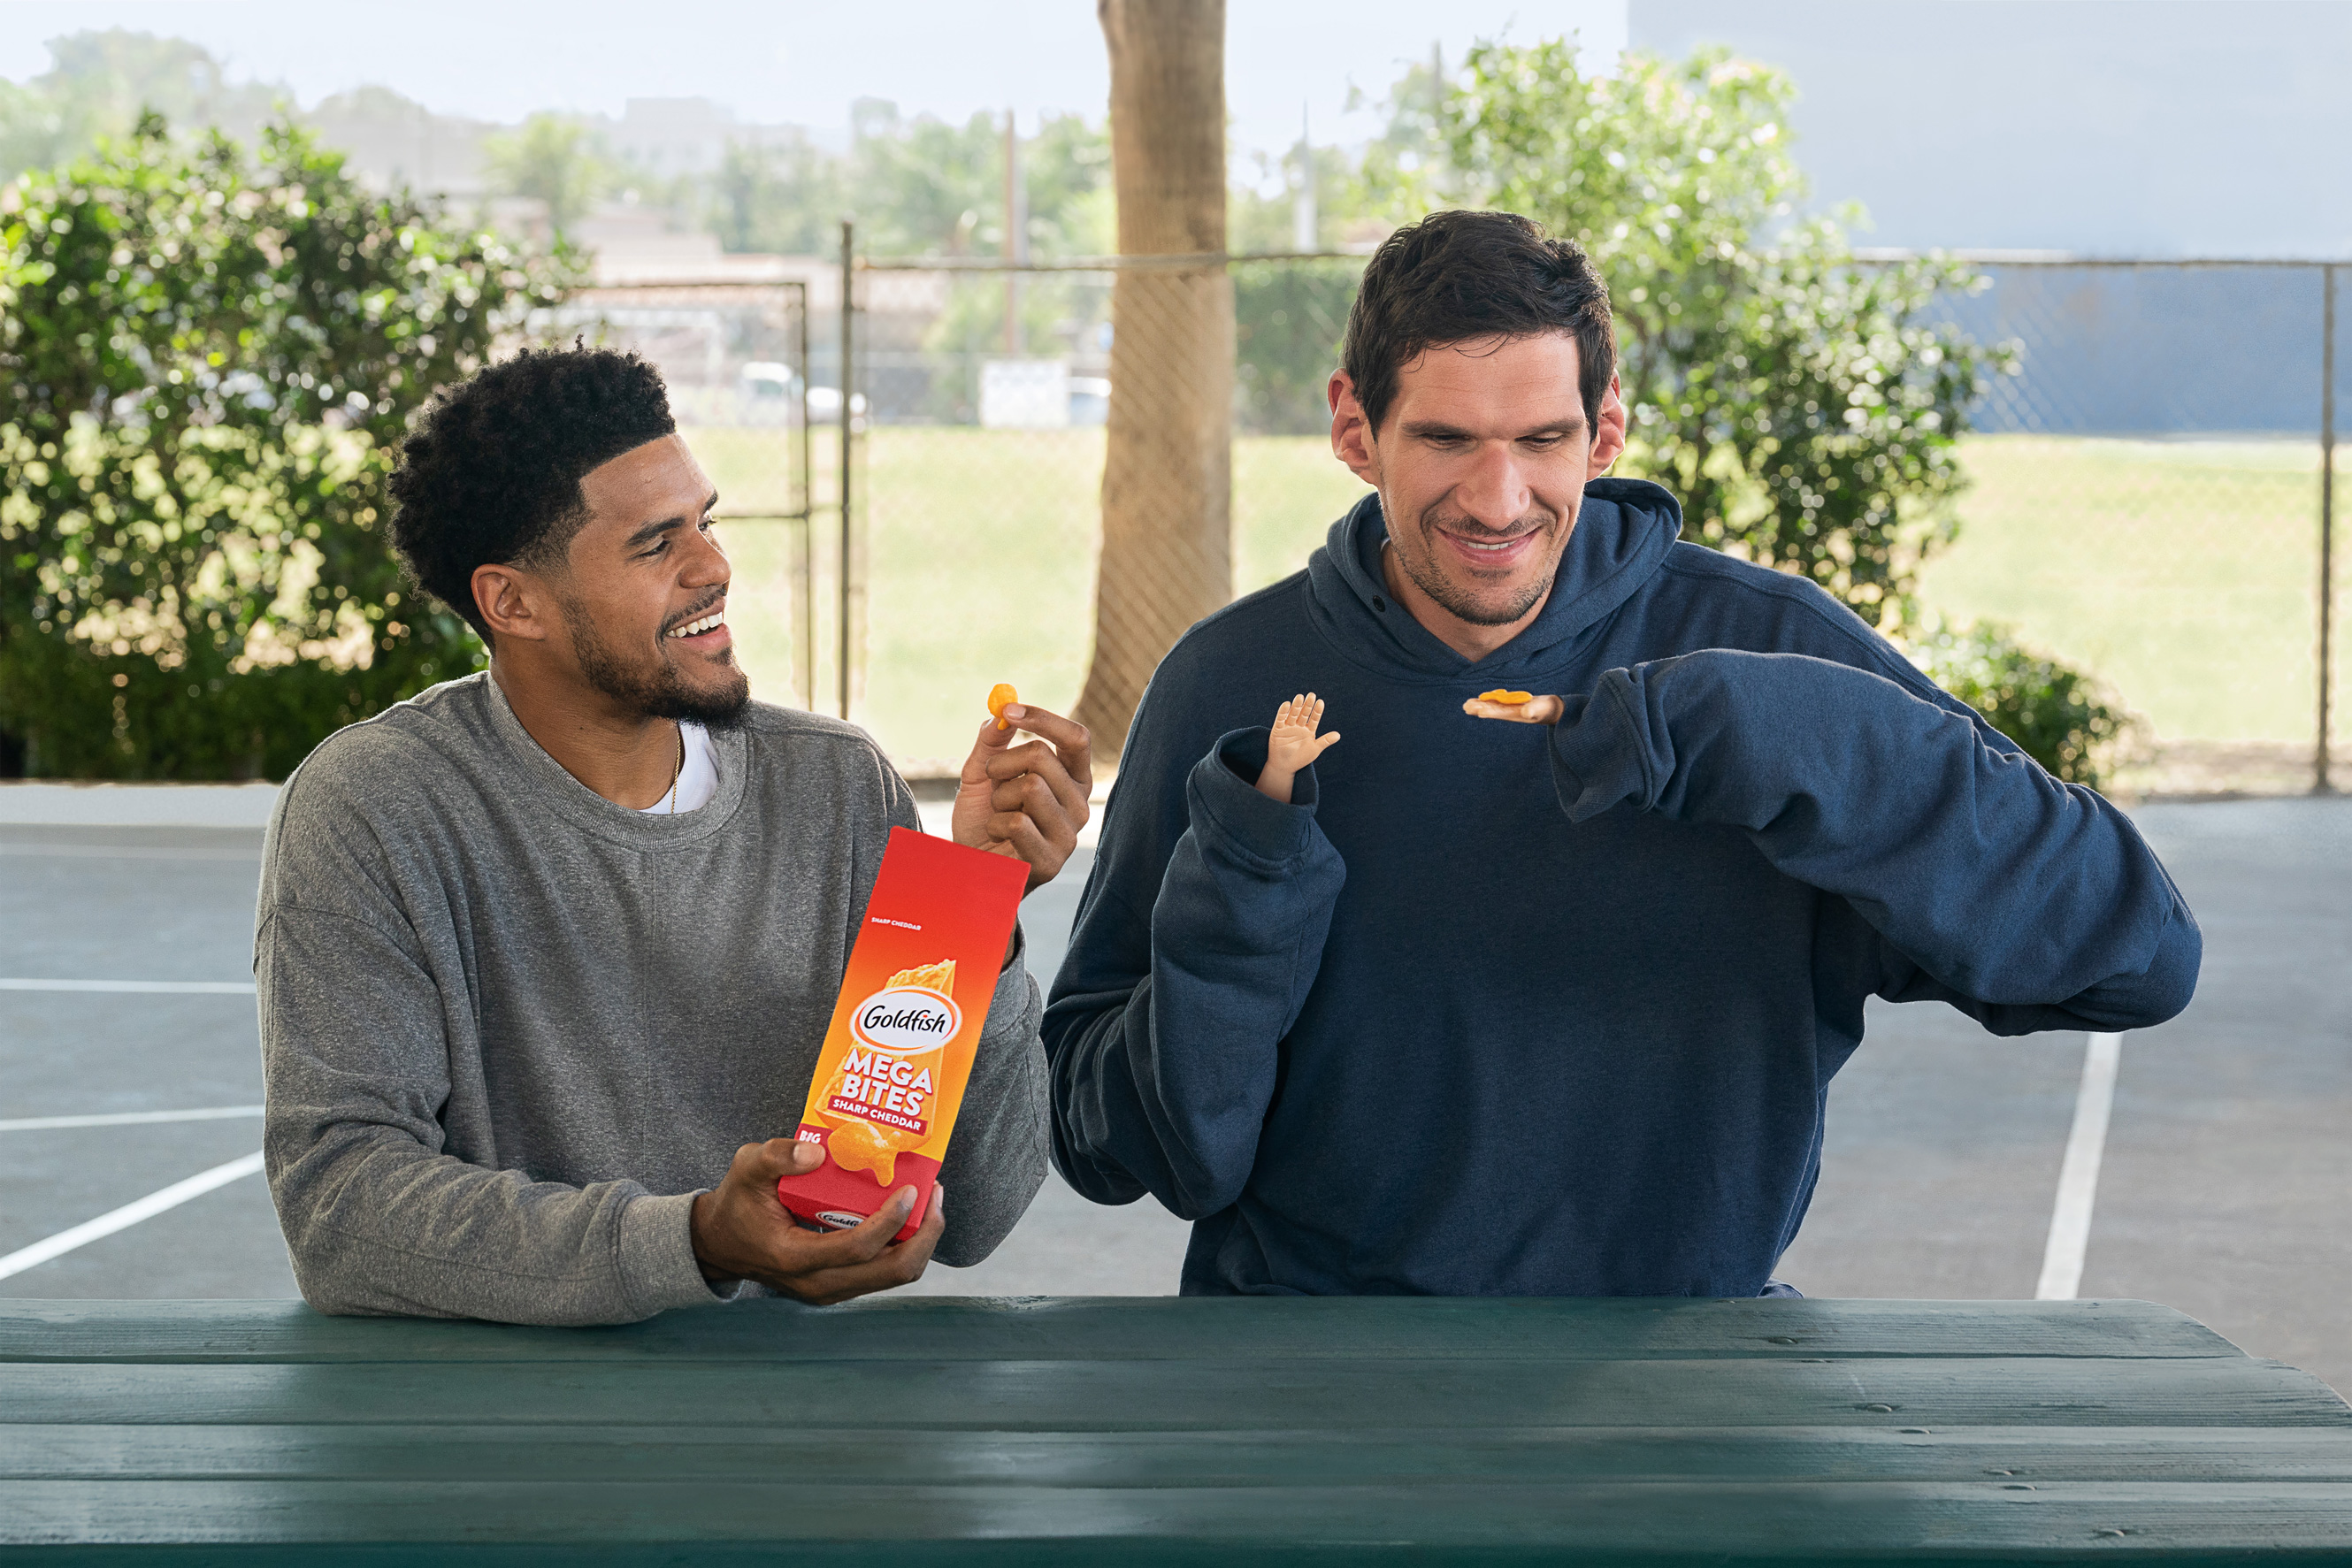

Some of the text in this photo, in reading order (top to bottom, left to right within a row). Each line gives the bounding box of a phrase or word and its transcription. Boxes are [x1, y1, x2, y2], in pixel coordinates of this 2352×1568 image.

[891, 920, 922, 930] CHEDDAR
[863, 1005, 946, 1034] Goldfish
[843, 1047, 933, 1095] MEGA
[840, 1073, 923, 1116] BITES
[832, 1098, 922, 1131] SHARP CHEDDAR
[799, 1129, 821, 1144] BIG
[823, 1214, 859, 1228] Goldfi
